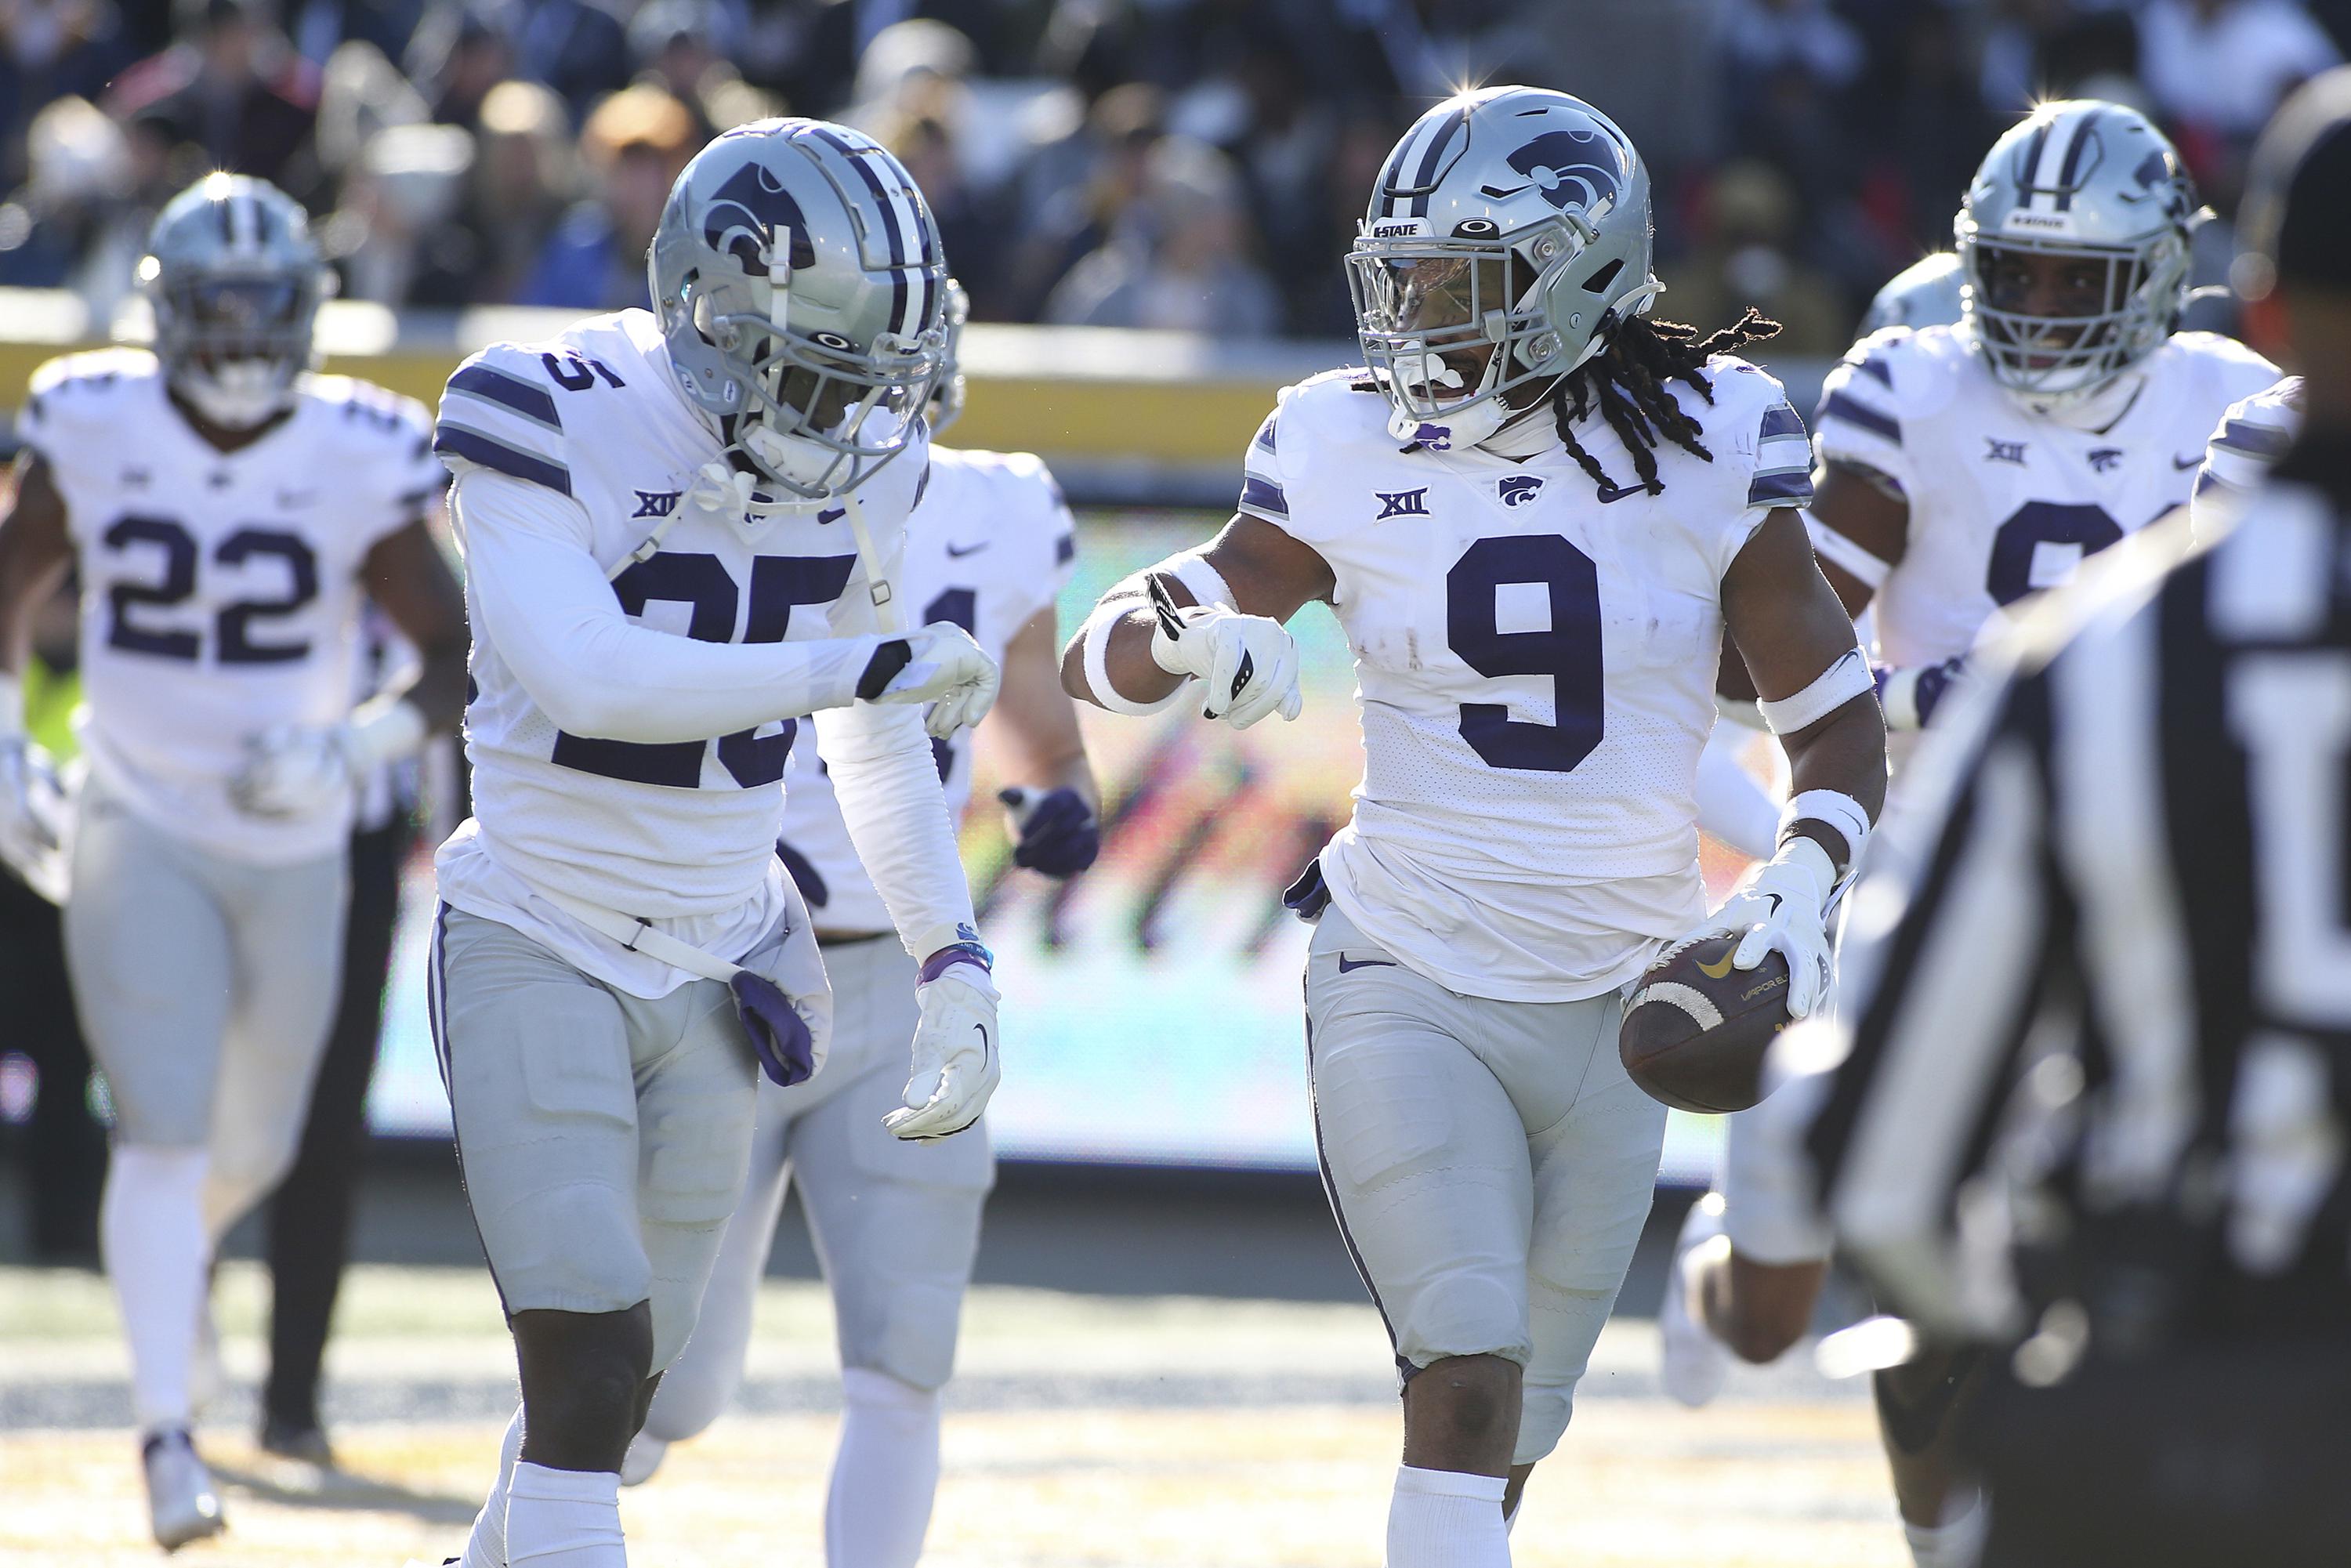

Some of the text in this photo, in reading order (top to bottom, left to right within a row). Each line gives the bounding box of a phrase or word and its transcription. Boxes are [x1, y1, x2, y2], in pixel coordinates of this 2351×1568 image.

[1374, 224, 1418, 237] K-STATE
[1375, 487, 1430, 520] XII
[104, 516, 318, 664] 22
[1447, 534, 1604, 773] 9
[1741, 980, 1777, 1001] VAPOR
